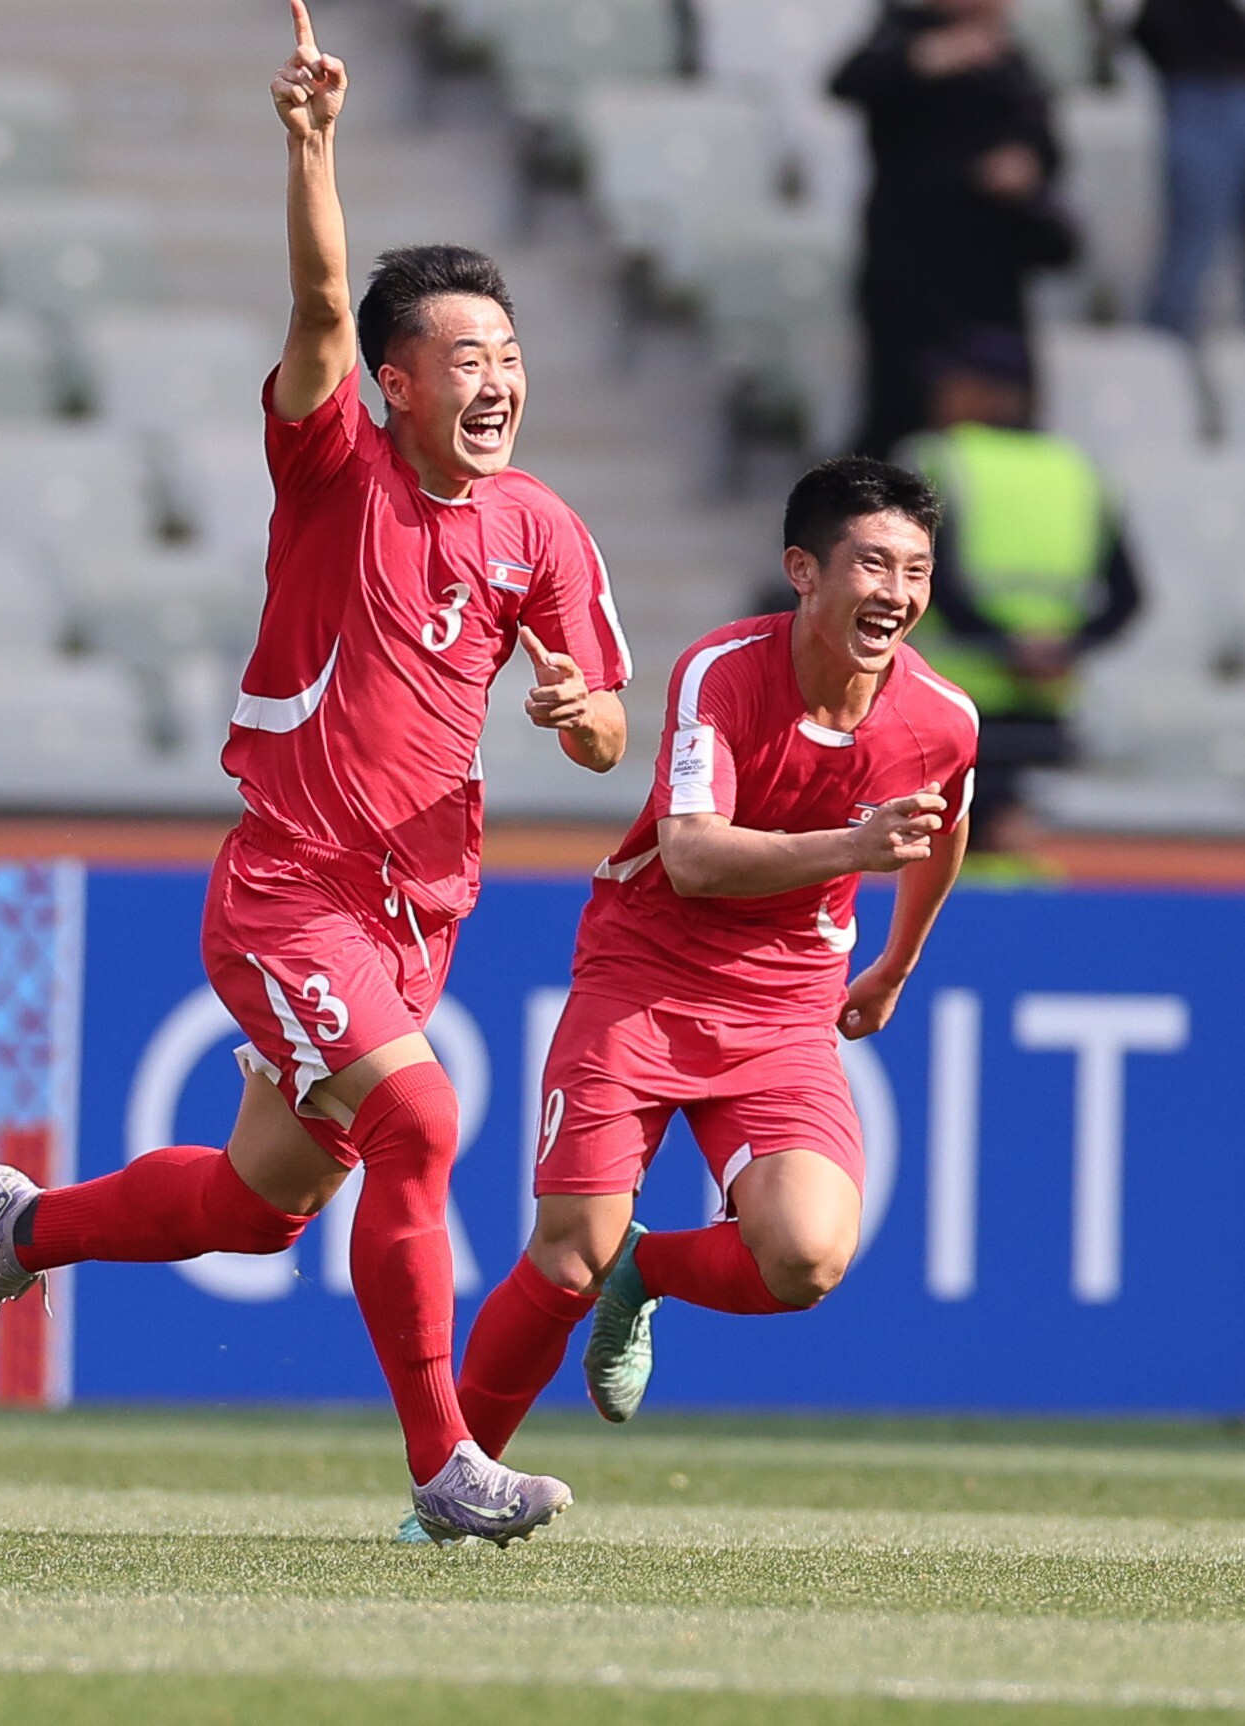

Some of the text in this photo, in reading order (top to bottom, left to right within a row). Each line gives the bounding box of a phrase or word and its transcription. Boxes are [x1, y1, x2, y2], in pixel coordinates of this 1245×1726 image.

[421, 583, 471, 652] 3
[302, 973, 349, 1042] 3
[538, 1088, 565, 1163] 9
